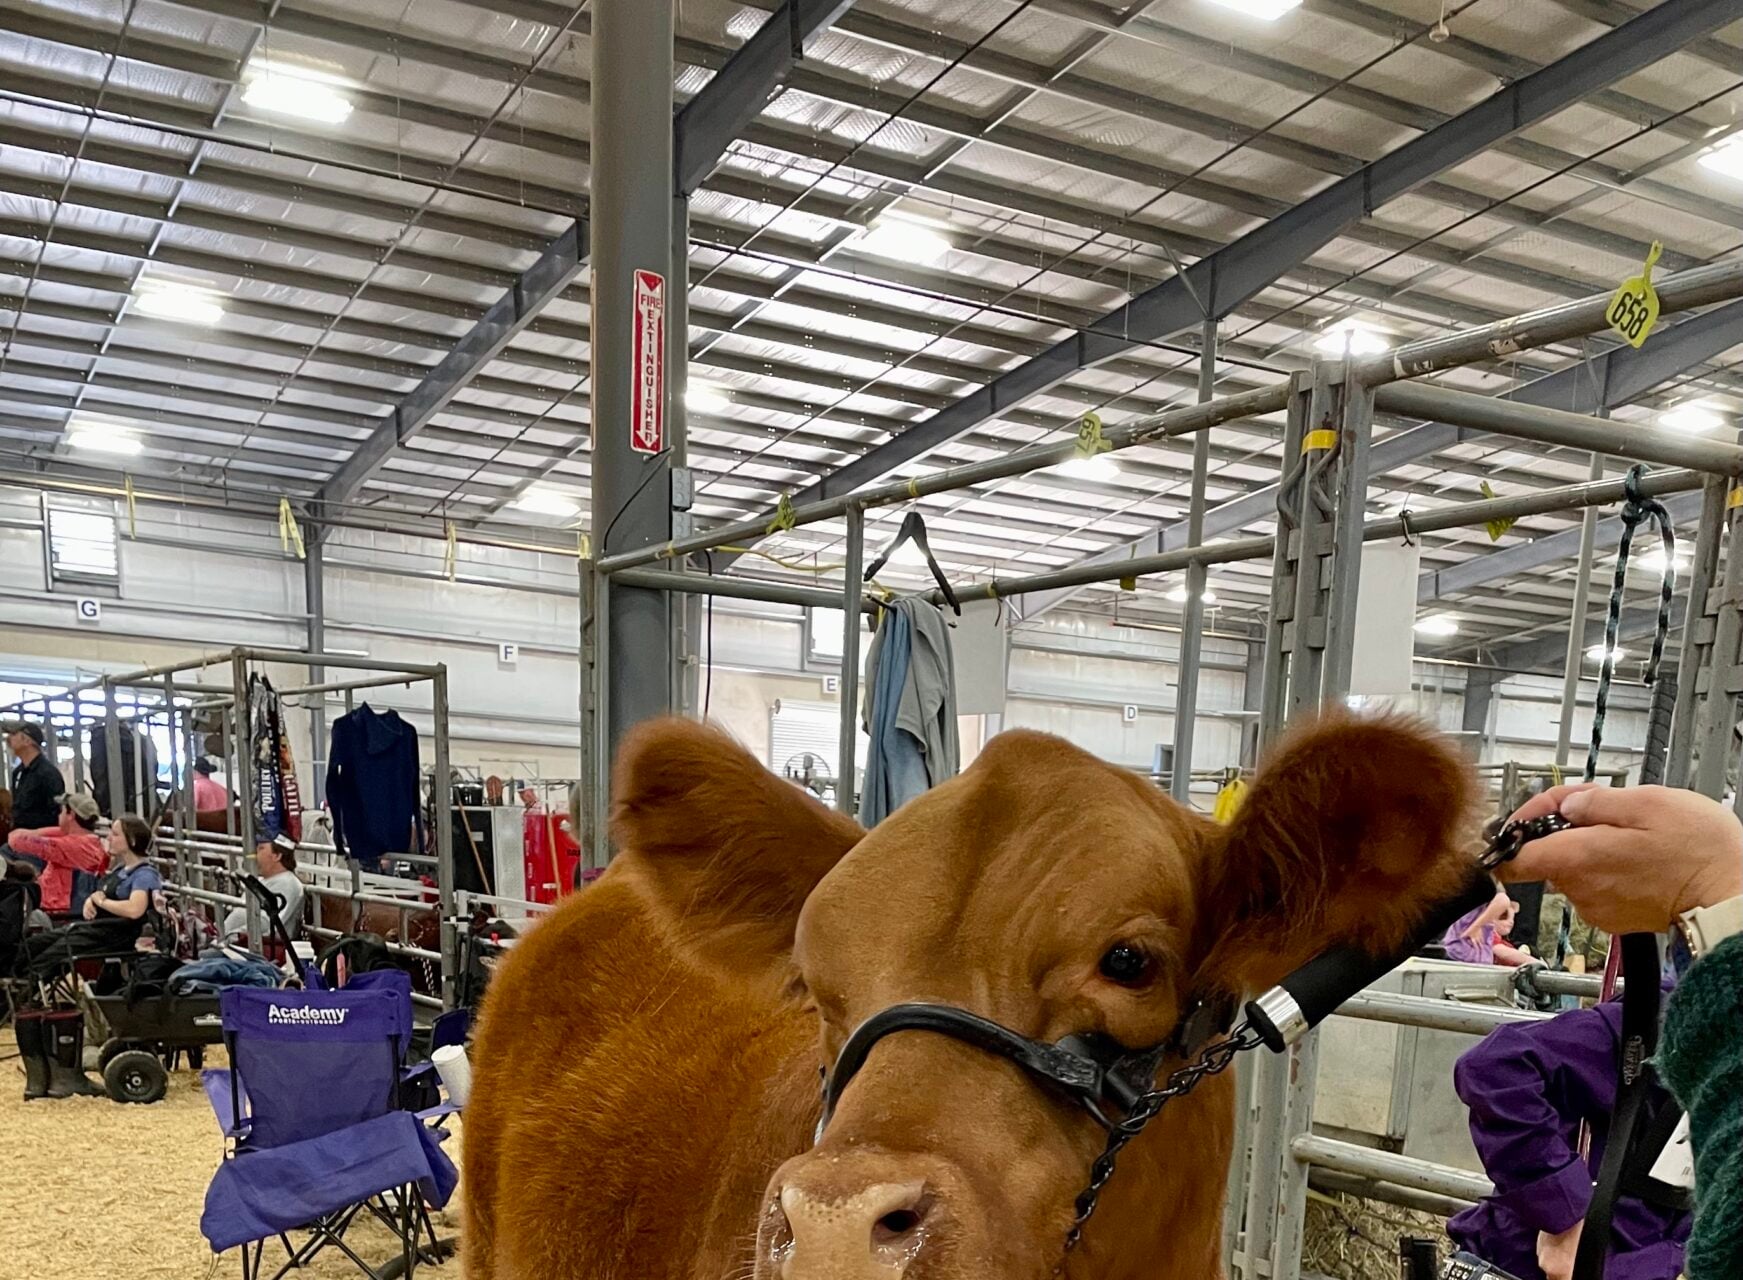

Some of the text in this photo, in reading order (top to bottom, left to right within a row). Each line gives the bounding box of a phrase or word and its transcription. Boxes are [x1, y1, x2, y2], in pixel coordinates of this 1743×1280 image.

[640, 293, 662, 310] FIRE
[1612, 292, 1649, 339] 658
[644, 309, 655, 442] EXTINGUISHER
[1076, 418, 1096, 453] 657
[81, 599, 98, 617] G
[504, 645, 514, 661] F
[826, 678, 837, 692] E
[1127, 706, 1136, 720] D
[268, 1004, 345, 1023] Academy
